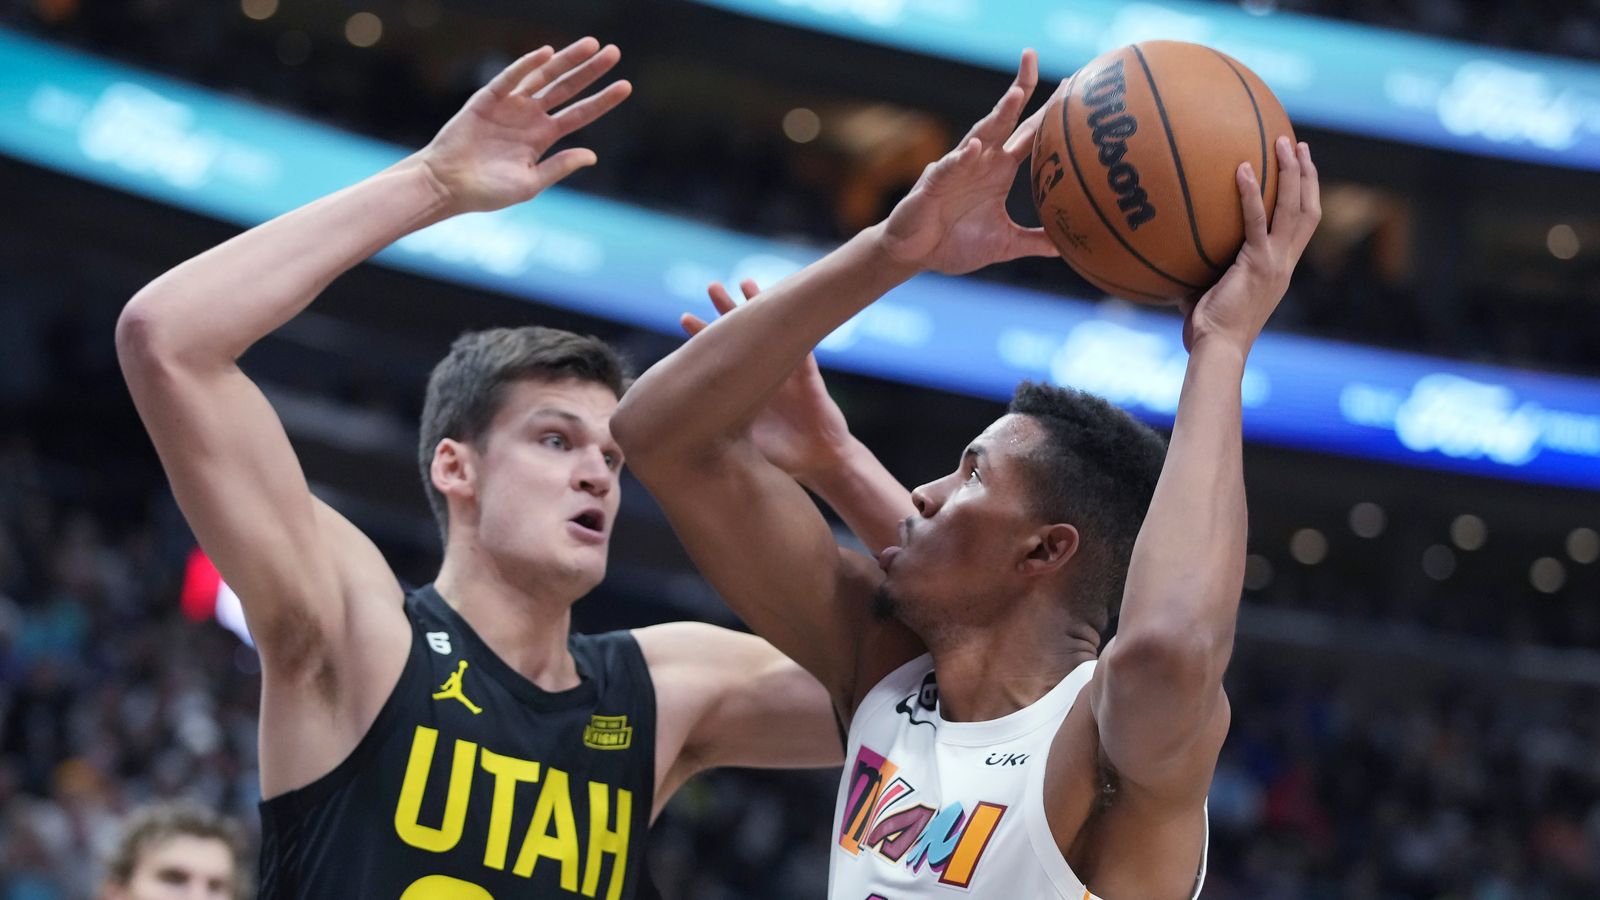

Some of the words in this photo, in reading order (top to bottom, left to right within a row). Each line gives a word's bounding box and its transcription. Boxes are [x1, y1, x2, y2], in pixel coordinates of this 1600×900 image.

[1081, 58, 1156, 232] Wilson
[425, 631, 452, 655] 6
[394, 724, 633, 900] UTAH
